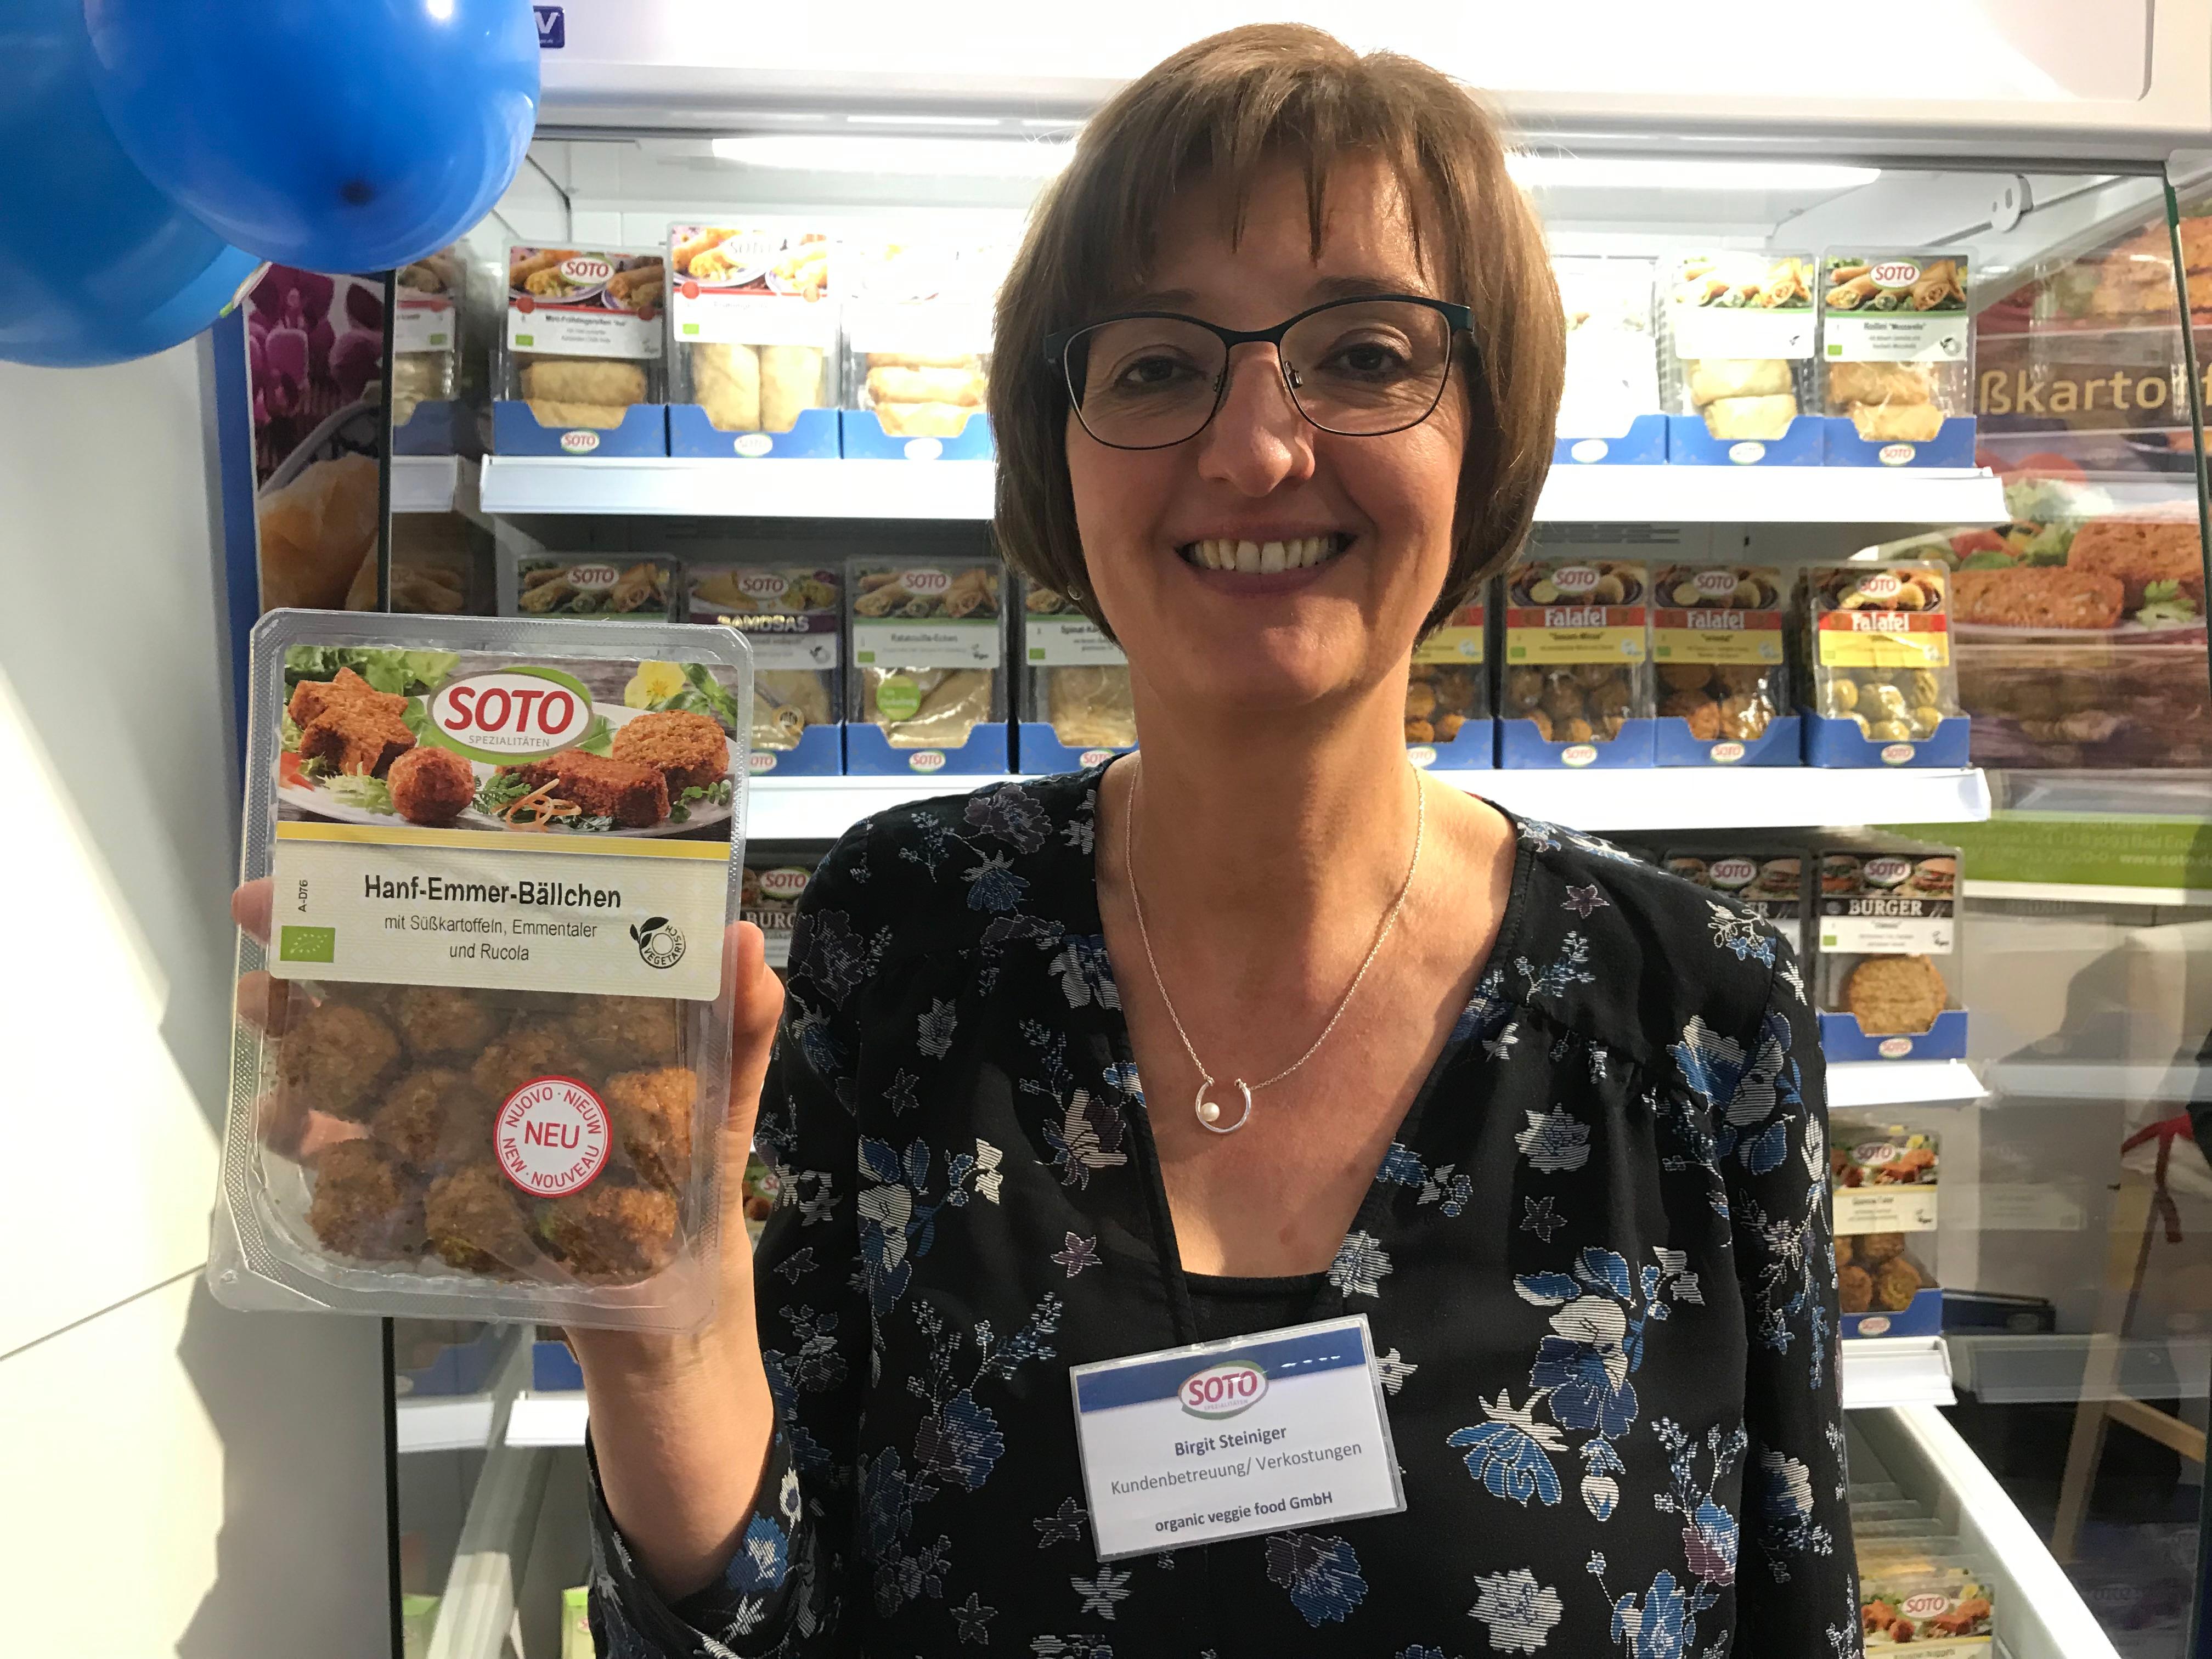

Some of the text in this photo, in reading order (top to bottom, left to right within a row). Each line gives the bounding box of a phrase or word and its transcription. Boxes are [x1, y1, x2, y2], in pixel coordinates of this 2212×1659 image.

[565, 261, 609, 278] SOTO
[1875, 266, 1916, 281] SOTO
[563, 434, 597, 448] SOTO
[1883, 447, 1912, 459] SOTO
[572, 567, 615, 584] SOTO
[906, 573, 947, 588] SOTO
[1554, 572, 1594, 585] SOTO
[1697, 574, 1734, 590] SOTO
[741, 578, 785, 594] SOTO
[1860, 577, 1897, 594] SOTO
[1545, 606, 1607, 627] Falafel
[1686, 609, 1745, 630] Falafel
[1852, 613, 1910, 631] Falafel
[445, 686, 575, 735] SOTO
[468, 733, 550, 748] SPEZIALITÄTEN
[912, 753, 942, 766] SOTO
[1566, 748, 1593, 759] SOTO
[1712, 746, 1741, 758] SOTO
[1884, 748, 1913, 759] SOTO
[750, 756, 774, 766] OTO
[1714, 865, 1752, 878] SOTO
[1868, 862, 1905, 877] SOTO
[765, 872, 806, 888] SOTO
[365, 874, 622, 909] Hanf-Emmer-Bällchen
[1848, 900, 1923, 916] BURGER
[384, 914, 598, 939] mit Süßkartoffeln, Emmentaler
[449, 944, 530, 962] und Rucola
[644, 924, 682, 966] VEGETARISCH
[505, 1086, 602, 1135] NUOVO NIEUW
[524, 1120, 580, 1149] NEU
[1857, 1145, 1893, 1159] SOTO
[503, 1137, 600, 1188] NEW NOUVEAU
[1188, 1369, 1259, 1407] SOTO
[1204, 1398, 1249, 1412] SPEZIALITÄTEN
[1175, 1427, 1287, 1457] Birgit Steiniger
[1111, 1442, 1362, 1496] Kundenbetreuung/ Verkostungen
[1155, 1491, 1333, 1533] organic veggie food GmbH
[1906, 1598, 1946, 1612] SOTO
